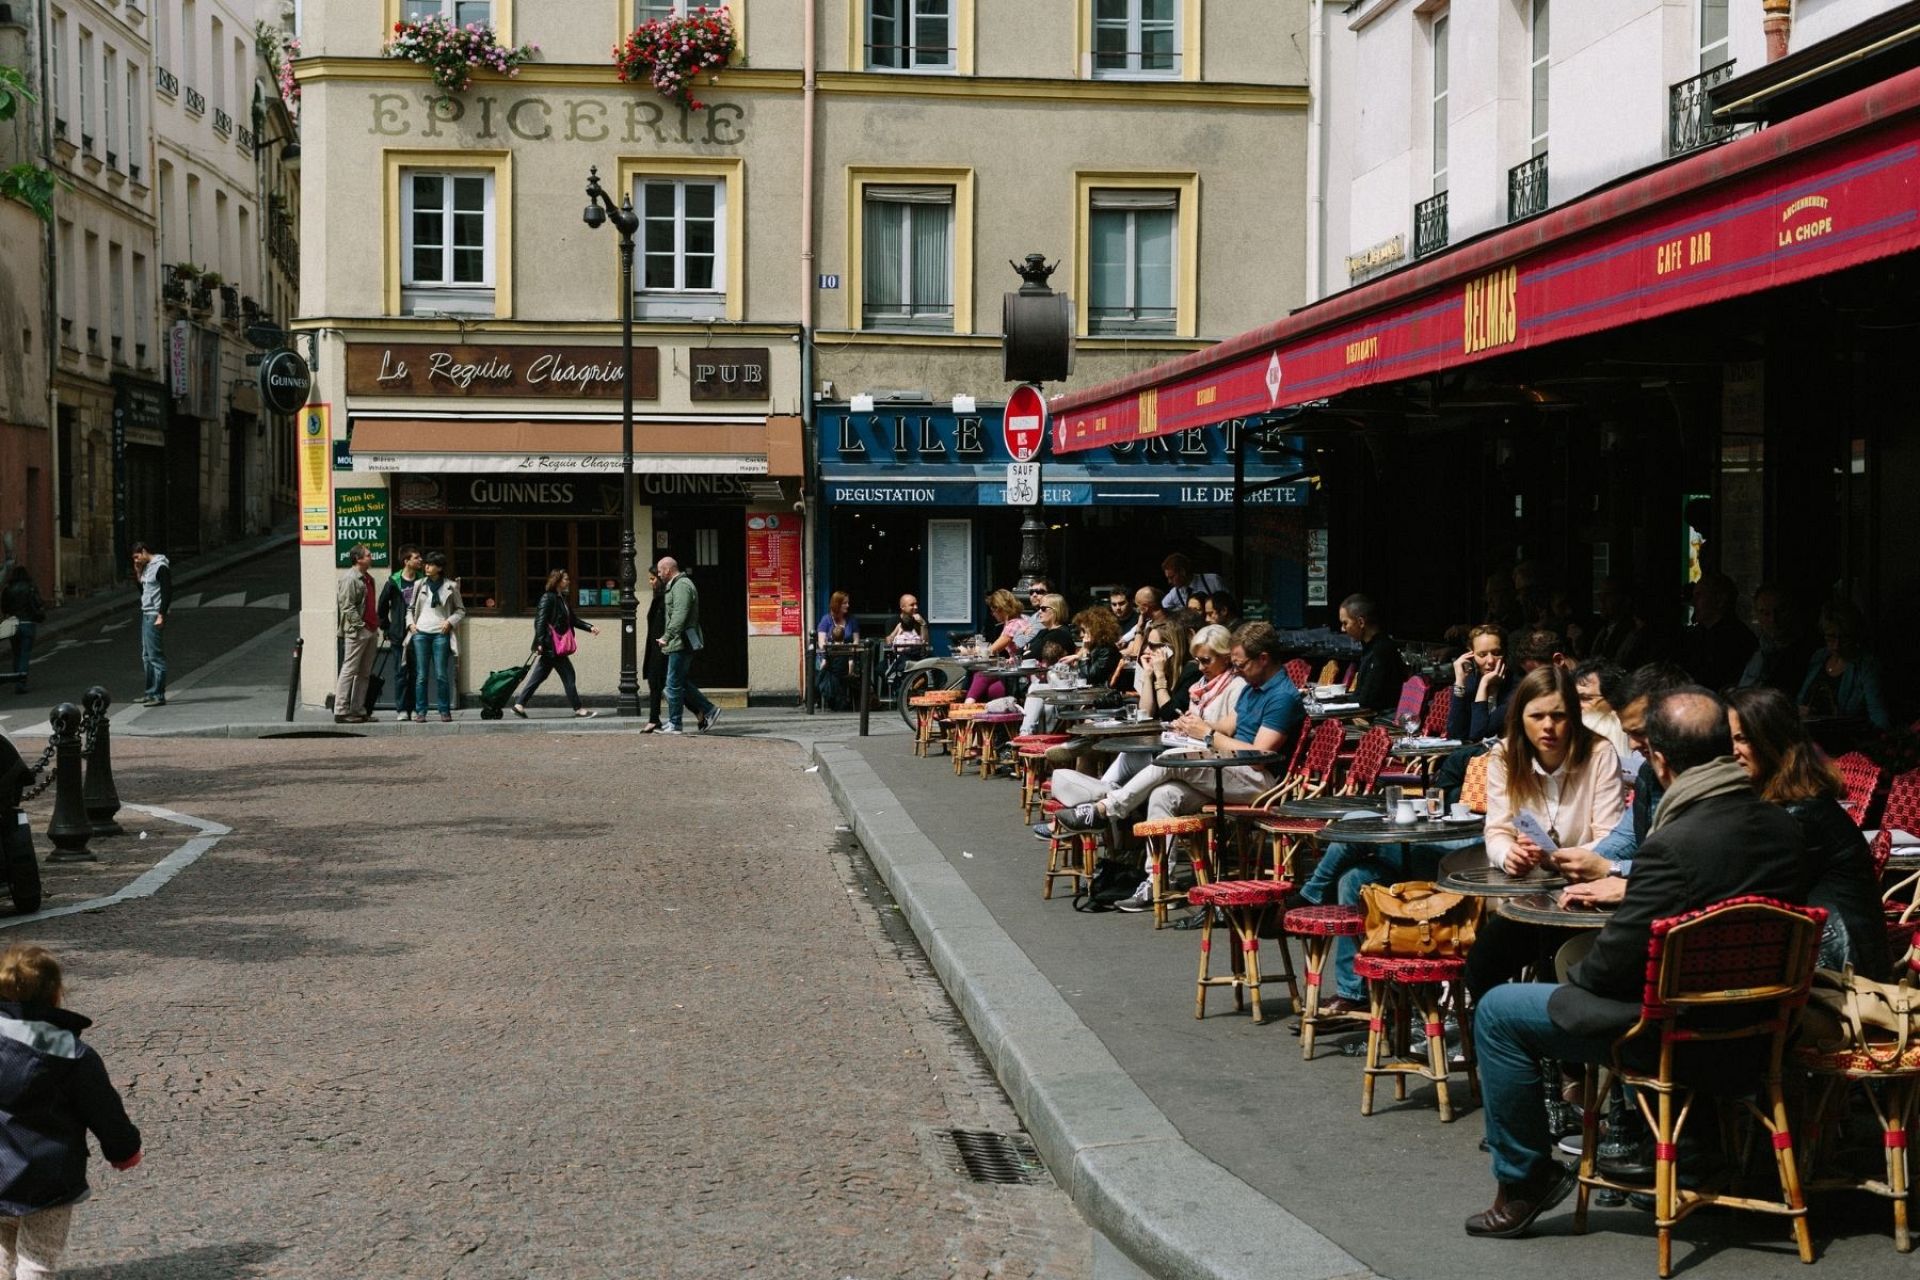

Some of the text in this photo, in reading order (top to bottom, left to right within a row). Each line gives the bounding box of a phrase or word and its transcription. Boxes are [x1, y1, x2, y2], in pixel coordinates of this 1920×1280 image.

[368, 93, 745, 146] EPICERIE
[1779, 216, 1832, 246] LA CHOPE
[1657, 231, 1711, 275] CAFE BAR
[822, 275, 836, 288] 10
[1465, 264, 1517, 355] DELMAS
[376, 350, 625, 392] Le Requin Chagrin
[695, 364, 762, 384] PUB
[518, 456, 534, 468] Le
[539, 456, 577, 471] Requin
[1013, 465, 1033, 476] SAUF
[341, 492, 375, 503] Tous les
[470, 479, 574, 503] GUINNESS
[835, 488, 935, 502] DEGUSTATION
[1181, 487, 1208, 502] ILE
[1213, 487, 1235, 502] DE
[367, 502, 385, 511] Soir
[338, 516, 384, 527] HAPPY
[337, 529, 378, 540] HOUR
